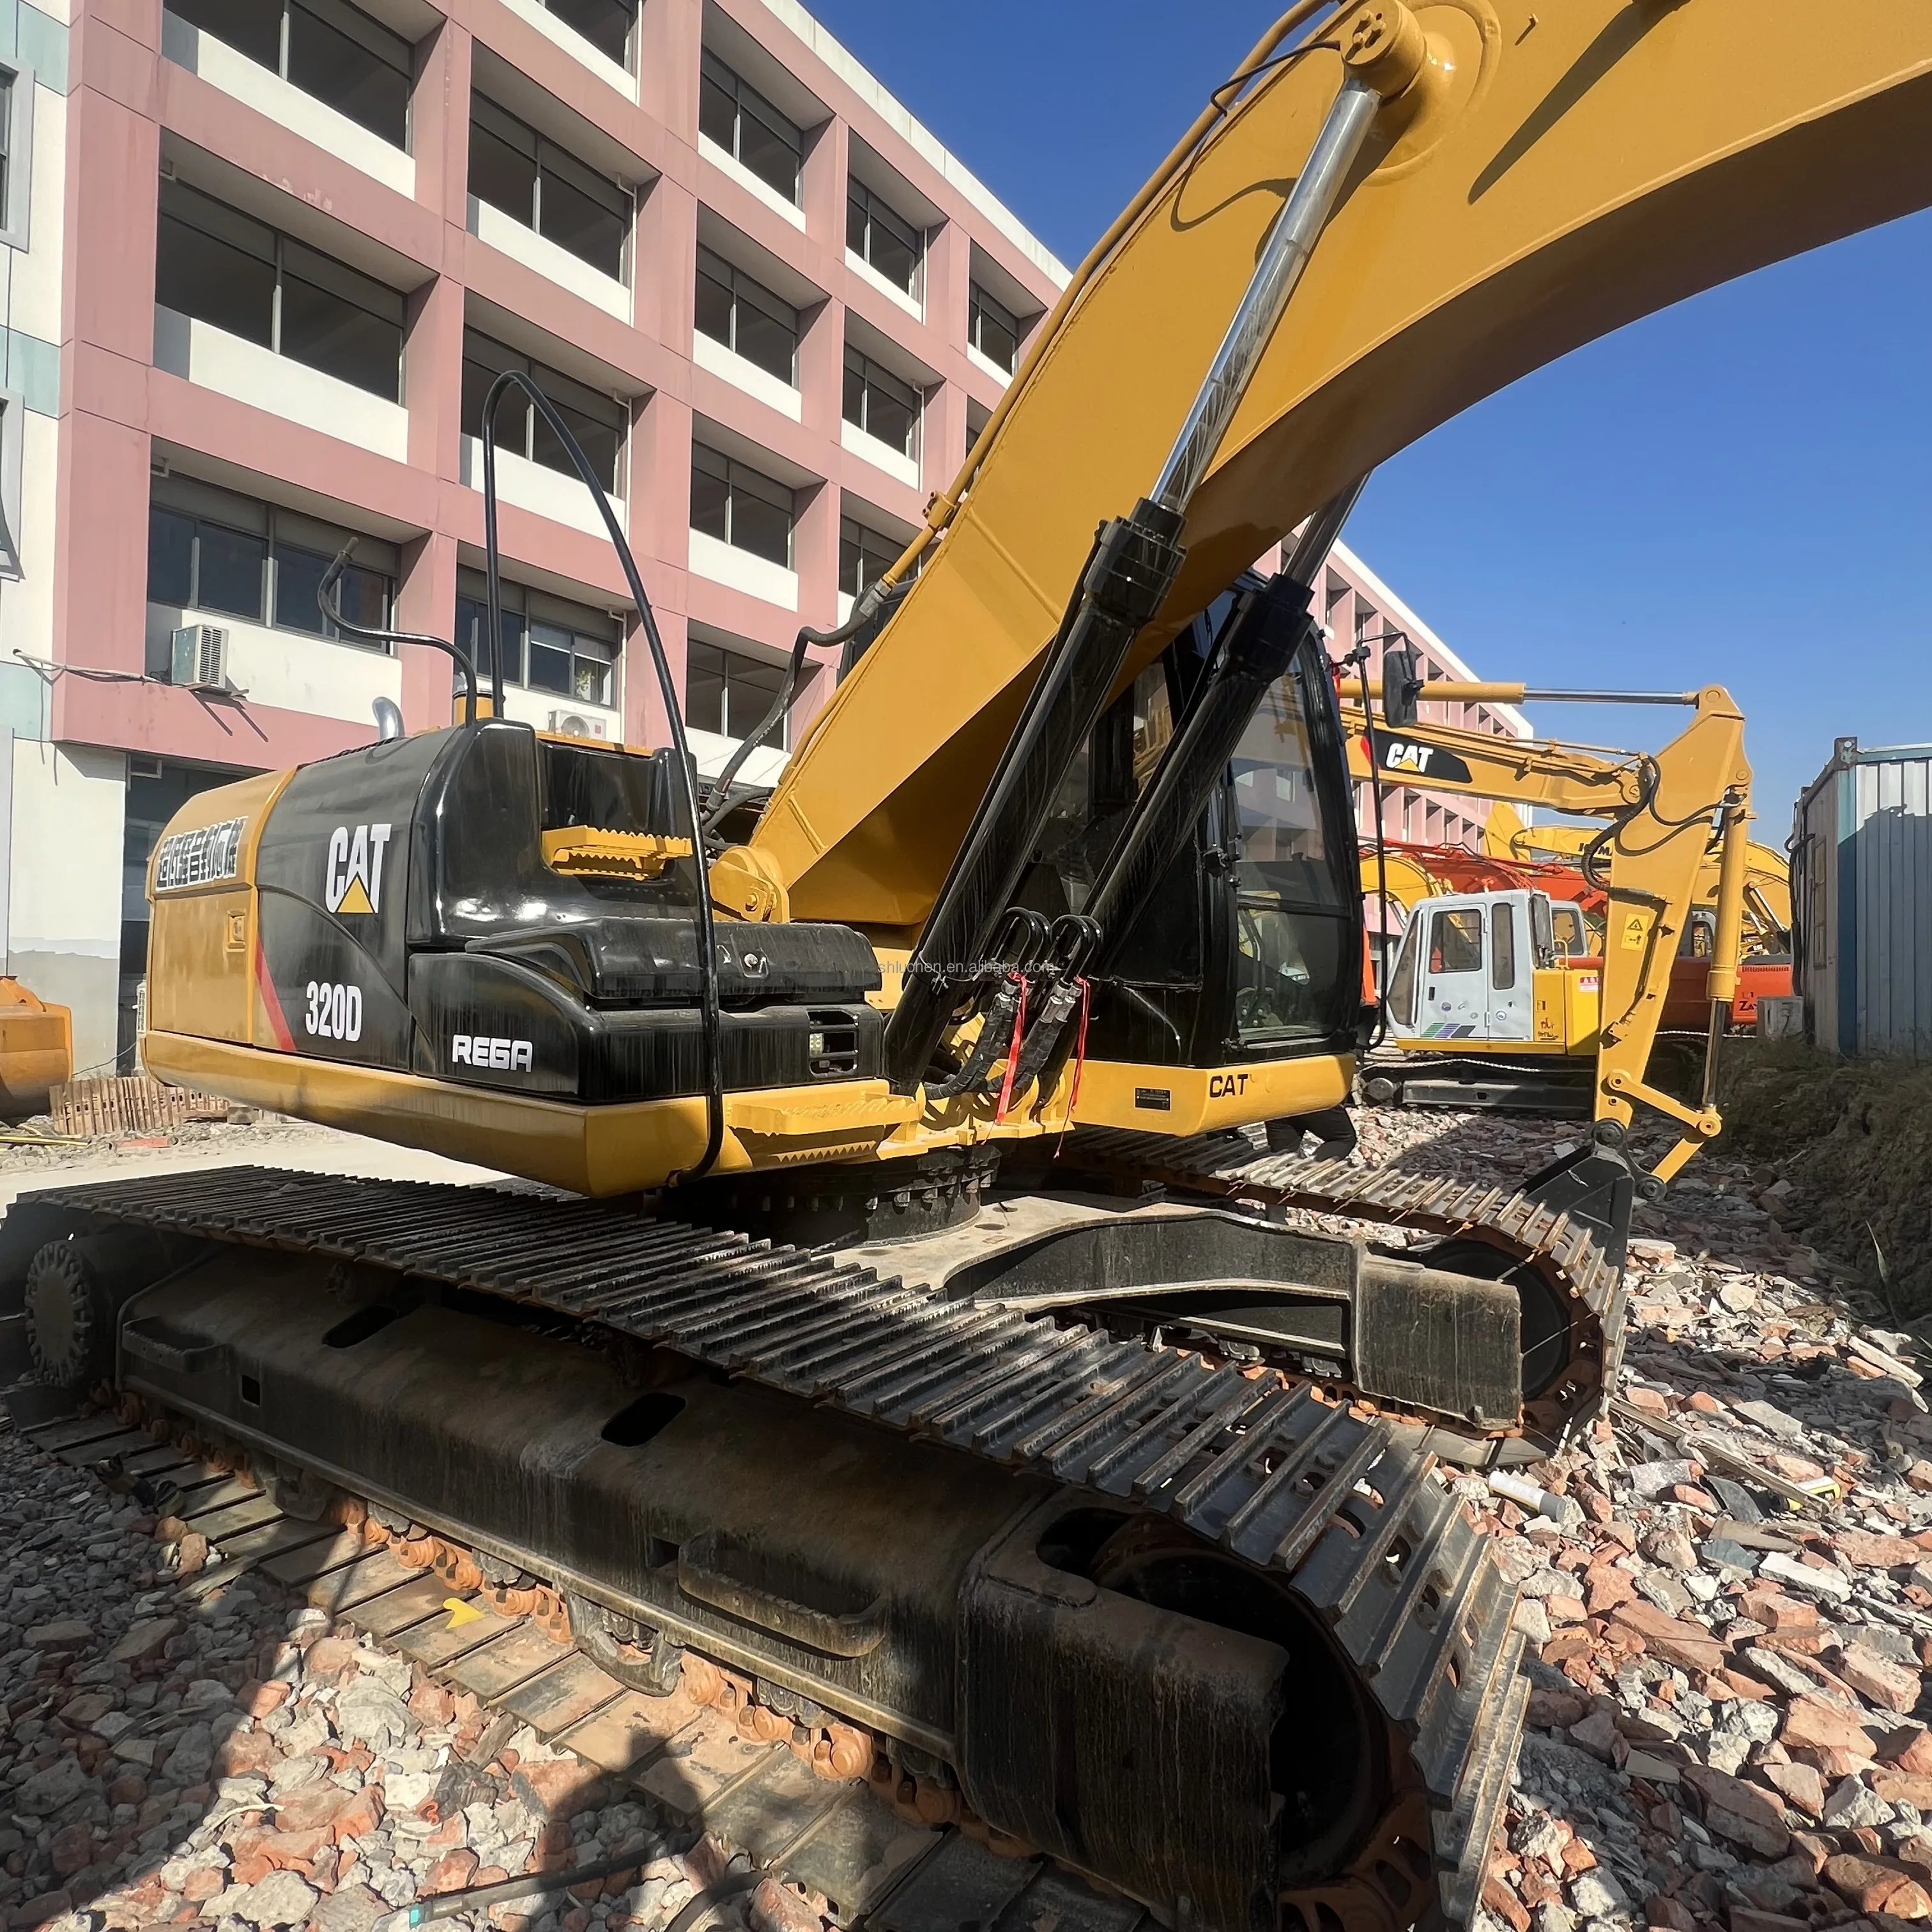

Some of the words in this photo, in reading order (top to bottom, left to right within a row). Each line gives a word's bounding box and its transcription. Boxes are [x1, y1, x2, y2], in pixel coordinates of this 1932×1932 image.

[1386, 743, 1434, 773] CAT
[326, 823, 392, 914] CAT
[305, 981, 362, 1041] 320D
[452, 1034, 533, 1073] REGA
[1209, 1073, 1248, 1098] CAT
